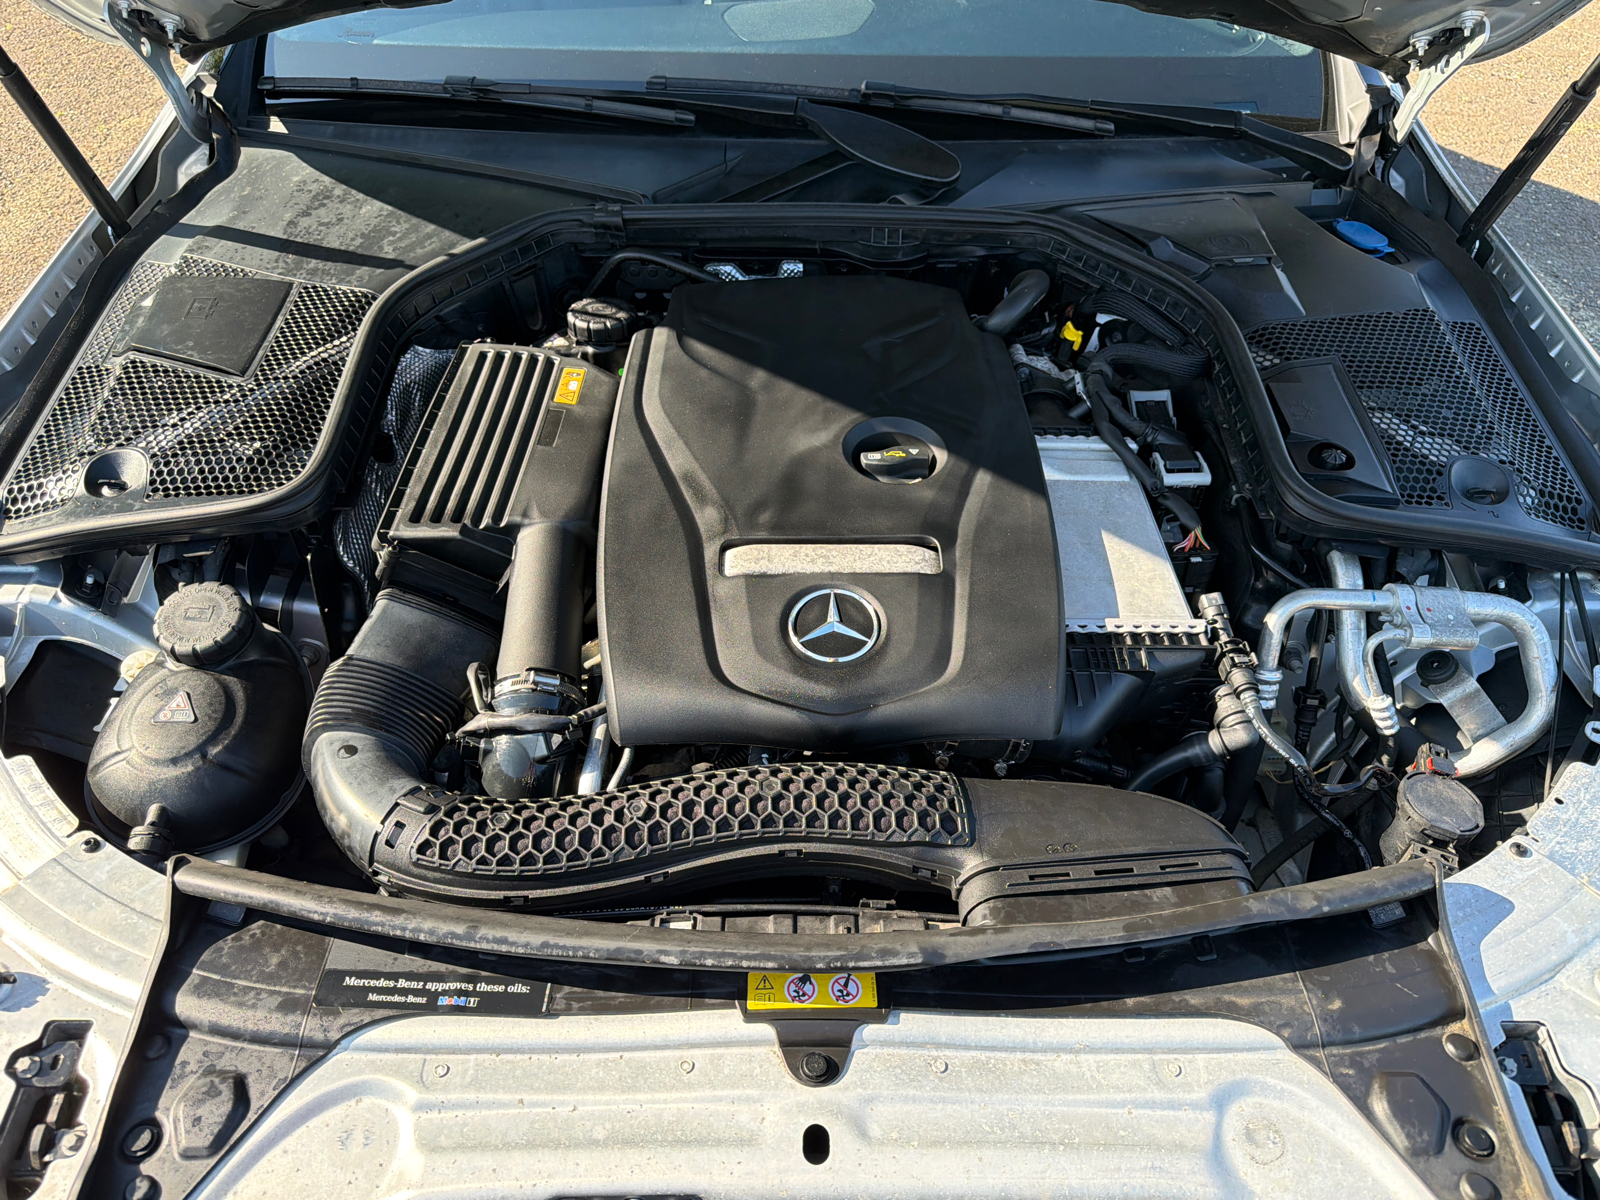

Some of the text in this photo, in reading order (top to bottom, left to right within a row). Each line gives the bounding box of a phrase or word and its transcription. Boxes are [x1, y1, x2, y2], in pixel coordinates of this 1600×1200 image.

[342, 976, 530, 993] Mercedes-Benz approves these oils:
[366, 993, 427, 1003] Mercedes-Benz
[437, 996, 467, 1006] Mobil
